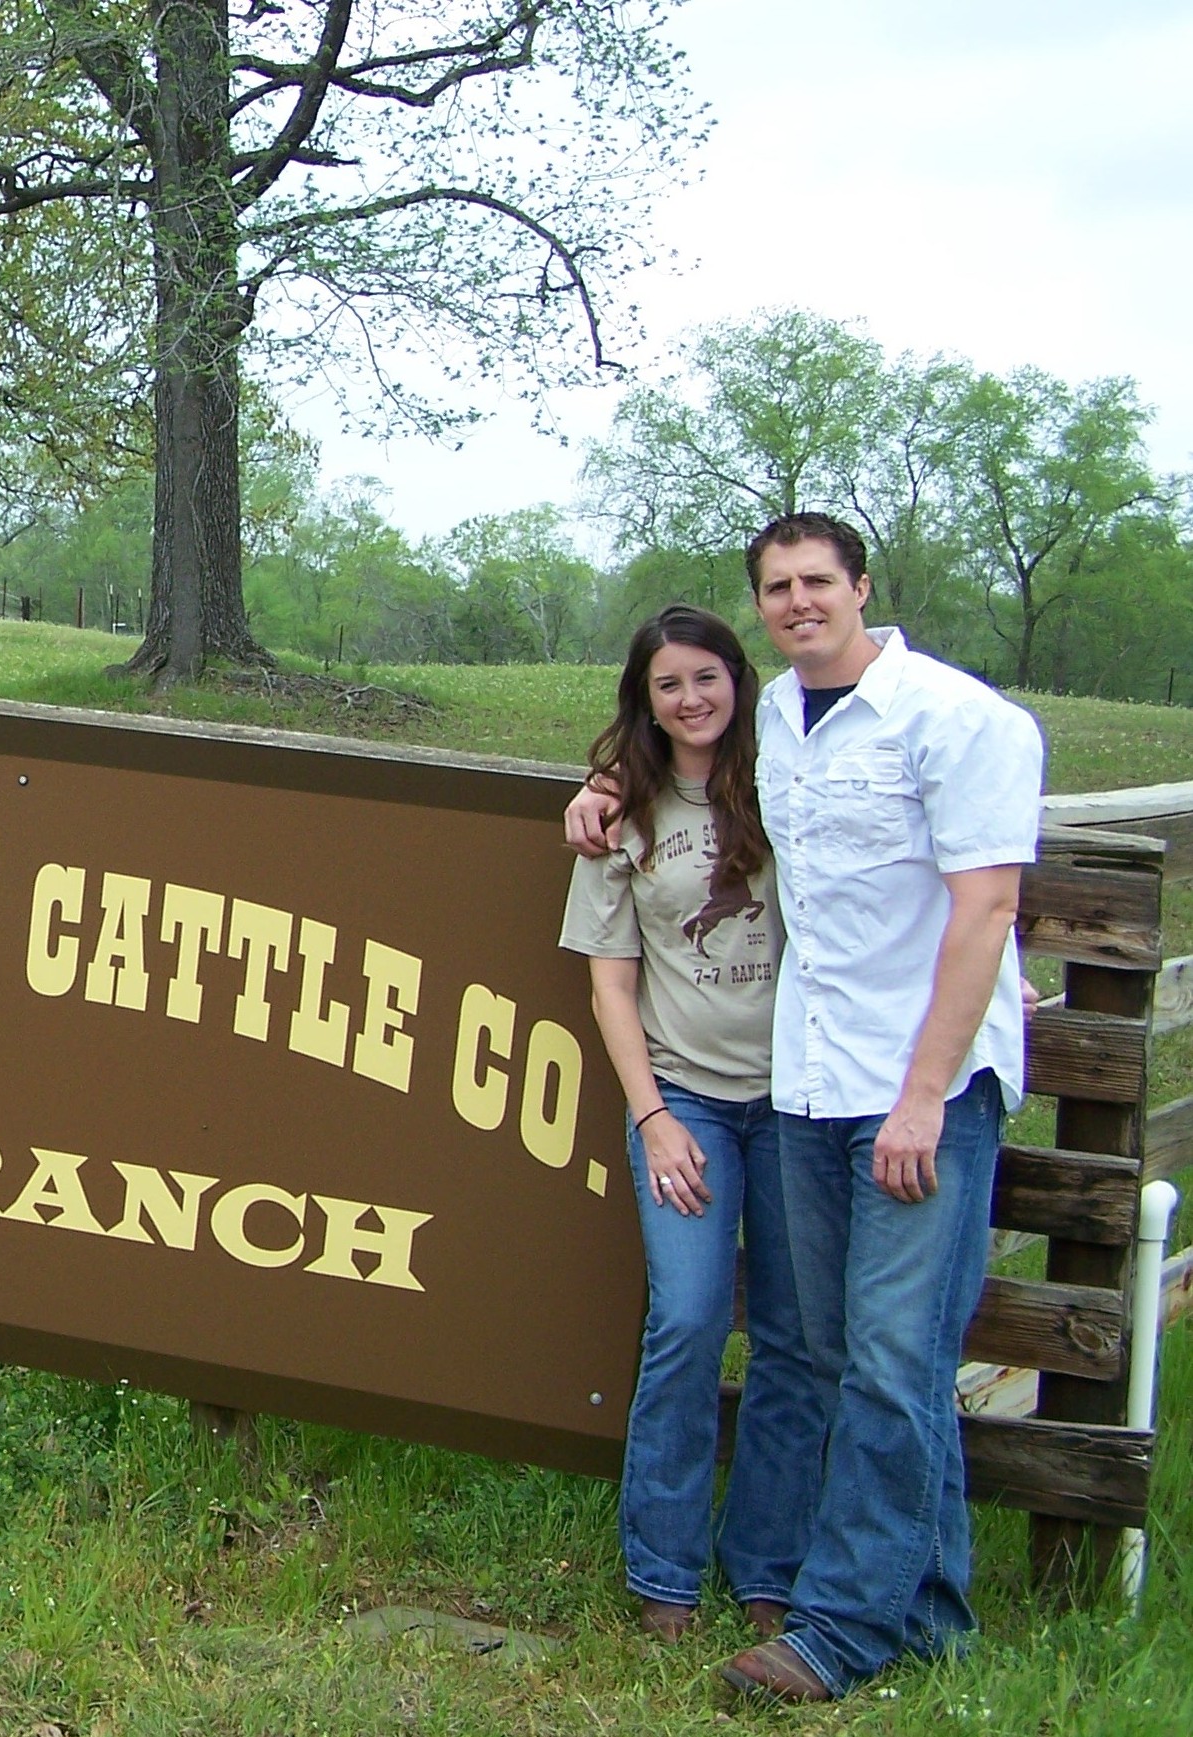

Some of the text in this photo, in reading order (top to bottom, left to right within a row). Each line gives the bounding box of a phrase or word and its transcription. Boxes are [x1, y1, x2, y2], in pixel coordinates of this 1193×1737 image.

[26, 863, 424, 1094] CATTLE
[452, 983, 608, 1197] CO.
[693, 962, 773, 986] 7-7 RANCH
